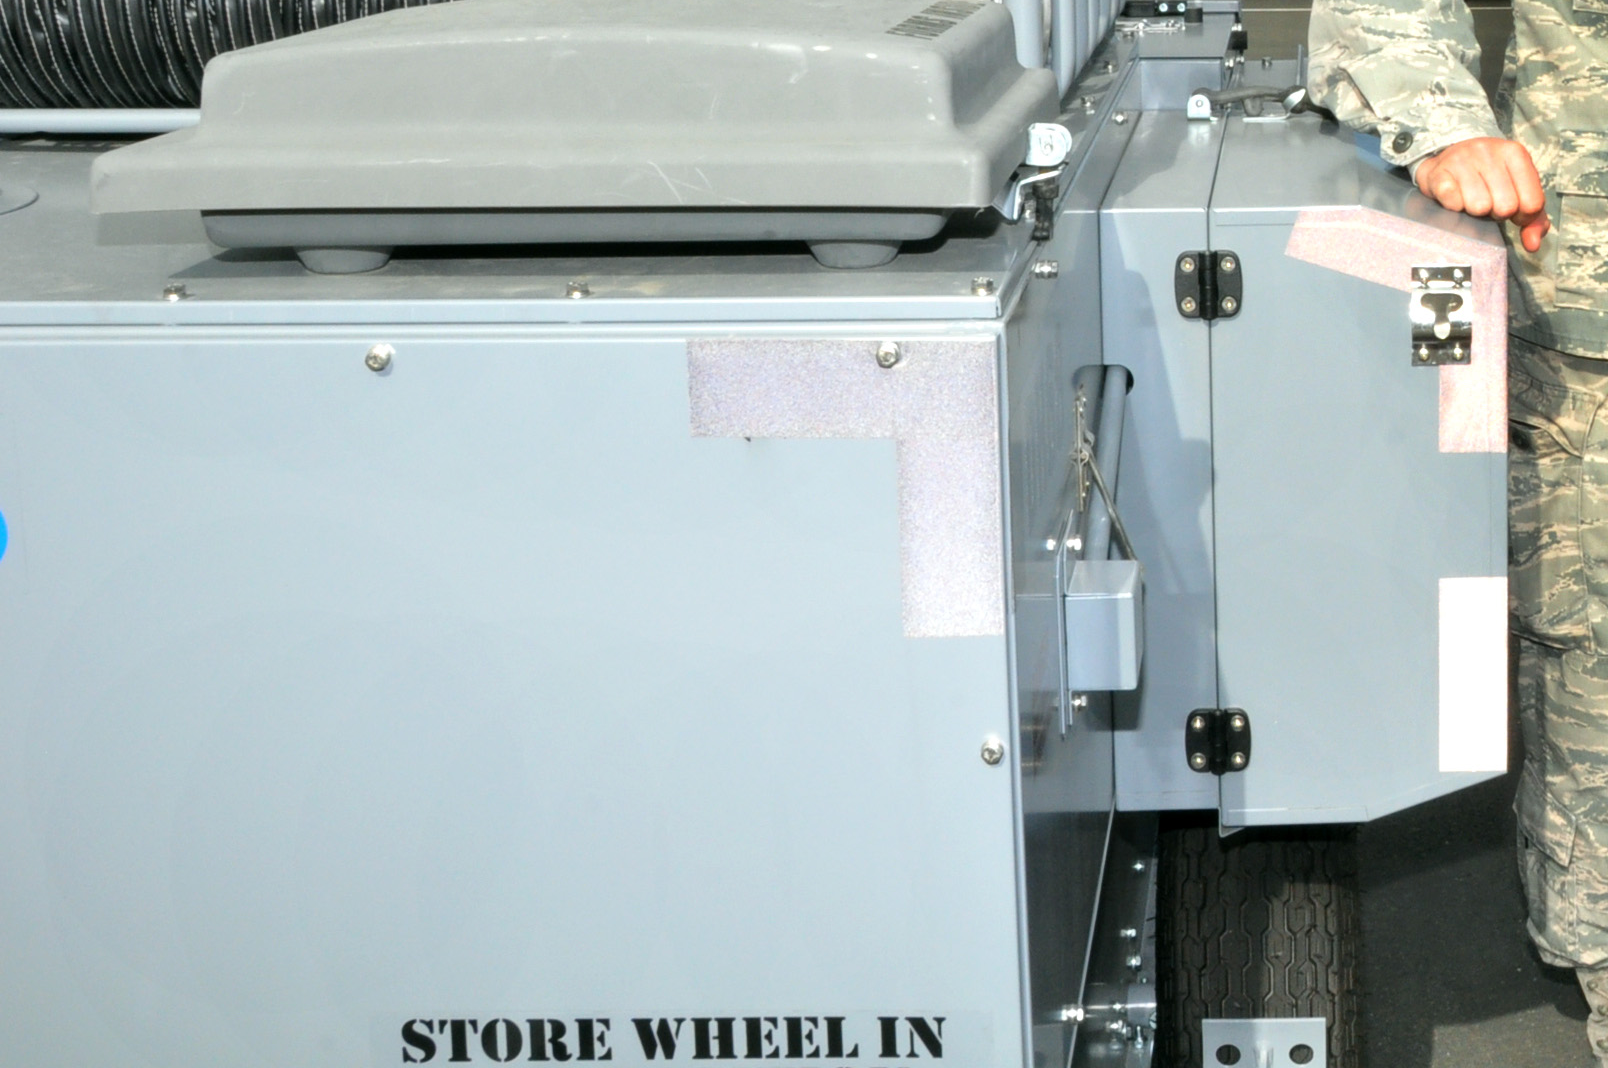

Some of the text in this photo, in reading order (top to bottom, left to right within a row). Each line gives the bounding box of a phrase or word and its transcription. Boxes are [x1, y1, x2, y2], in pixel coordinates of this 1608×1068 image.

[401, 1016, 947, 1064] STORE WHEEL IN
